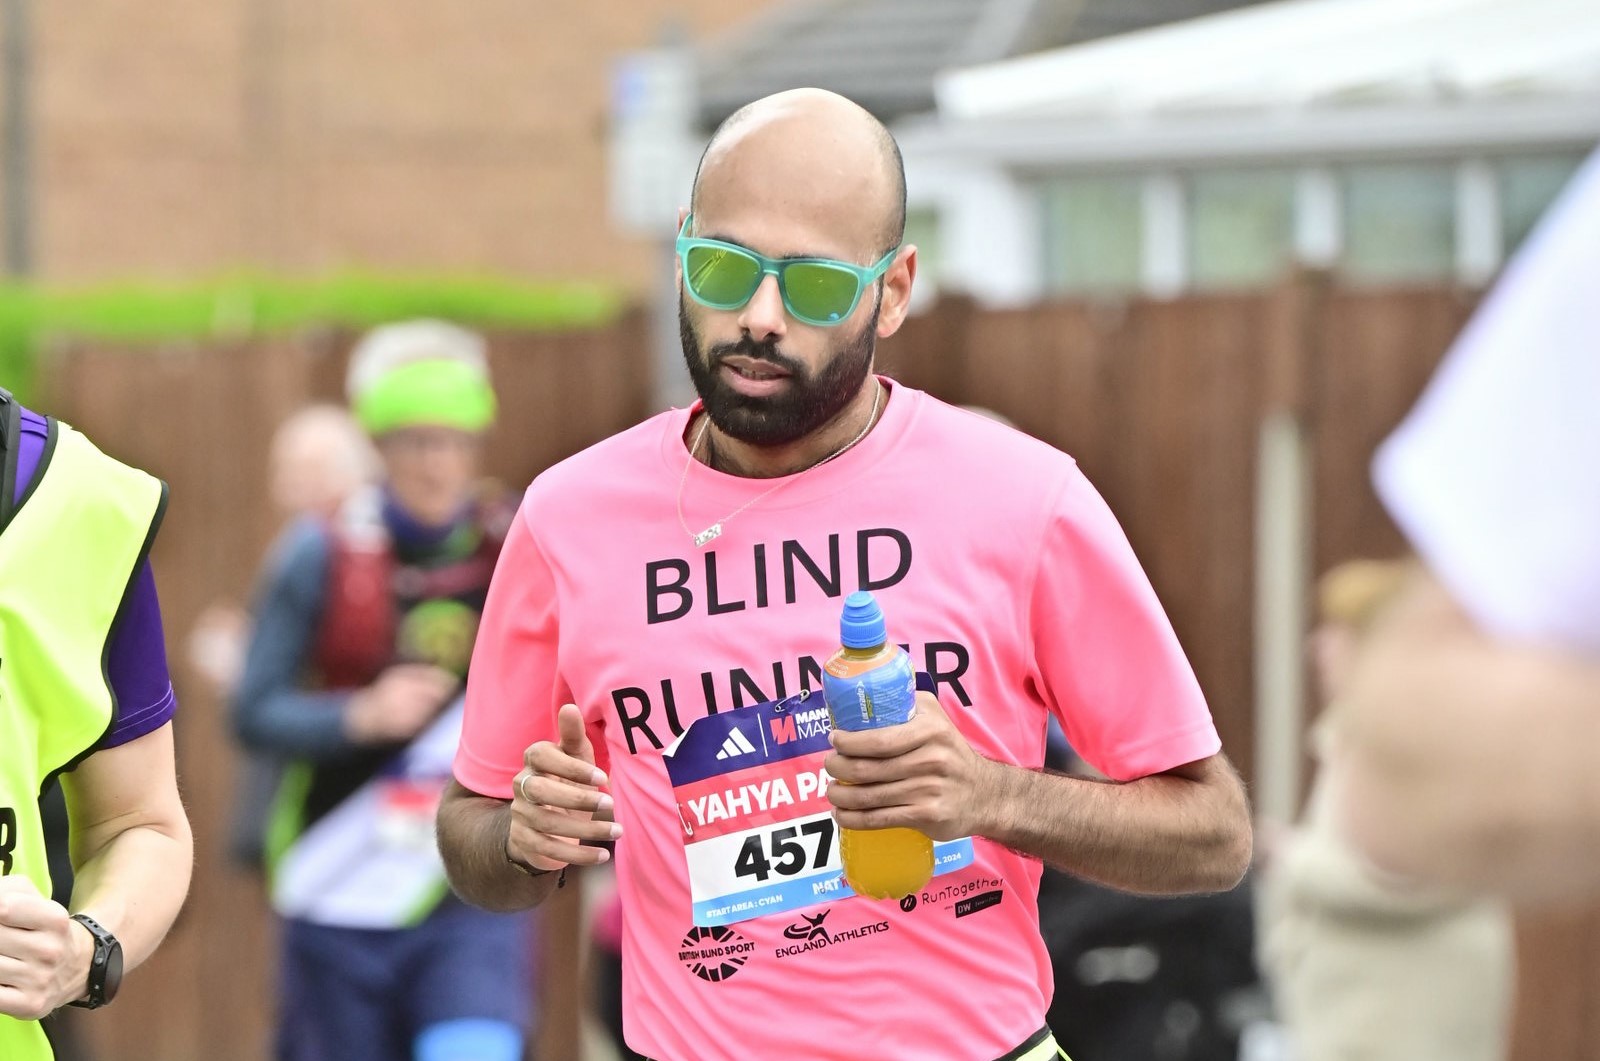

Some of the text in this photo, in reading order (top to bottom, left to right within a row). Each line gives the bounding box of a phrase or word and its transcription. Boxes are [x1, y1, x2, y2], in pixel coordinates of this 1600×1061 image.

[646, 527, 913, 624] BLIND
[611, 641, 974, 755] RUNR
[688, 777, 795, 826] YAHYA
[734, 818, 835, 882] 457
[943, 852, 962, 864] 2024
[706, 906, 731, 918] START
[758, 895, 783, 907] CYAN
[922, 879, 1004, 904] RunTogether
[678, 942, 755, 961] BRITISH BLIND SPORT
[775, 921, 890, 958] ENGLAND ATHLETICS
